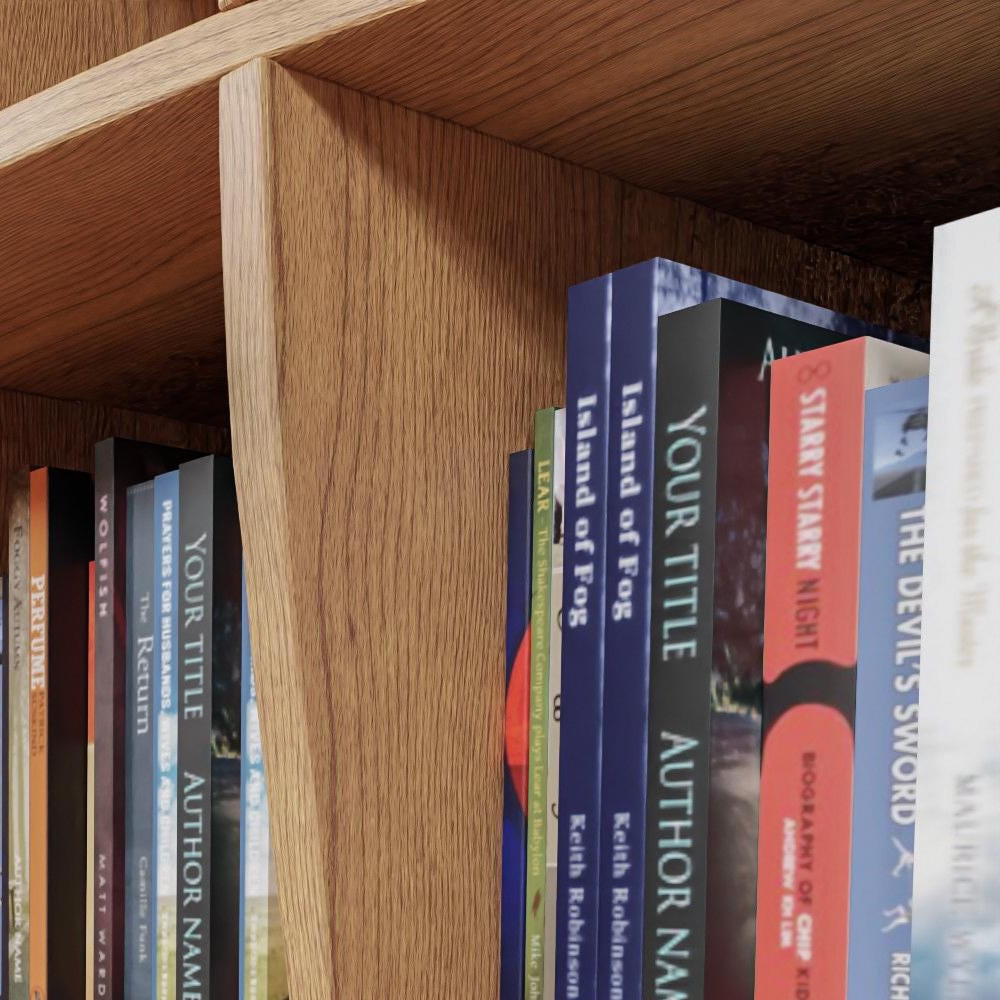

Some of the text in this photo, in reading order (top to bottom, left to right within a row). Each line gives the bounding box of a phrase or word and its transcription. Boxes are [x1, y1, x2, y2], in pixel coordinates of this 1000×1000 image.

[537, 459, 551, 512] LEAR
[568, 394, 598, 628] Island of Fog
[611, 380, 644, 622] Island of Fog
[662, 405, 708, 662] YOUR TITLE
[793, 387, 828, 650] STARRY STARRY NIGHT
[160, 499, 173, 614] PRAYERS FOR
[30, 573, 46, 690] PERFUME
[137, 634, 154, 735] Return
[183, 532, 207, 720] YOUR TITLE
[657, 731, 700, 914] AUTHOR
[798, 752, 818, 871] BIOGRAPHY
[890, 704, 920, 826] SWORD
[182, 771, 206, 906] AUTHOR
[612, 812, 632, 880] Keith
[798, 881, 814, 905] OF
[97, 854, 106, 996] MATT WARD
[566, 814, 587, 1000] Keith Robinson
[795, 913, 813, 962] CHIP
